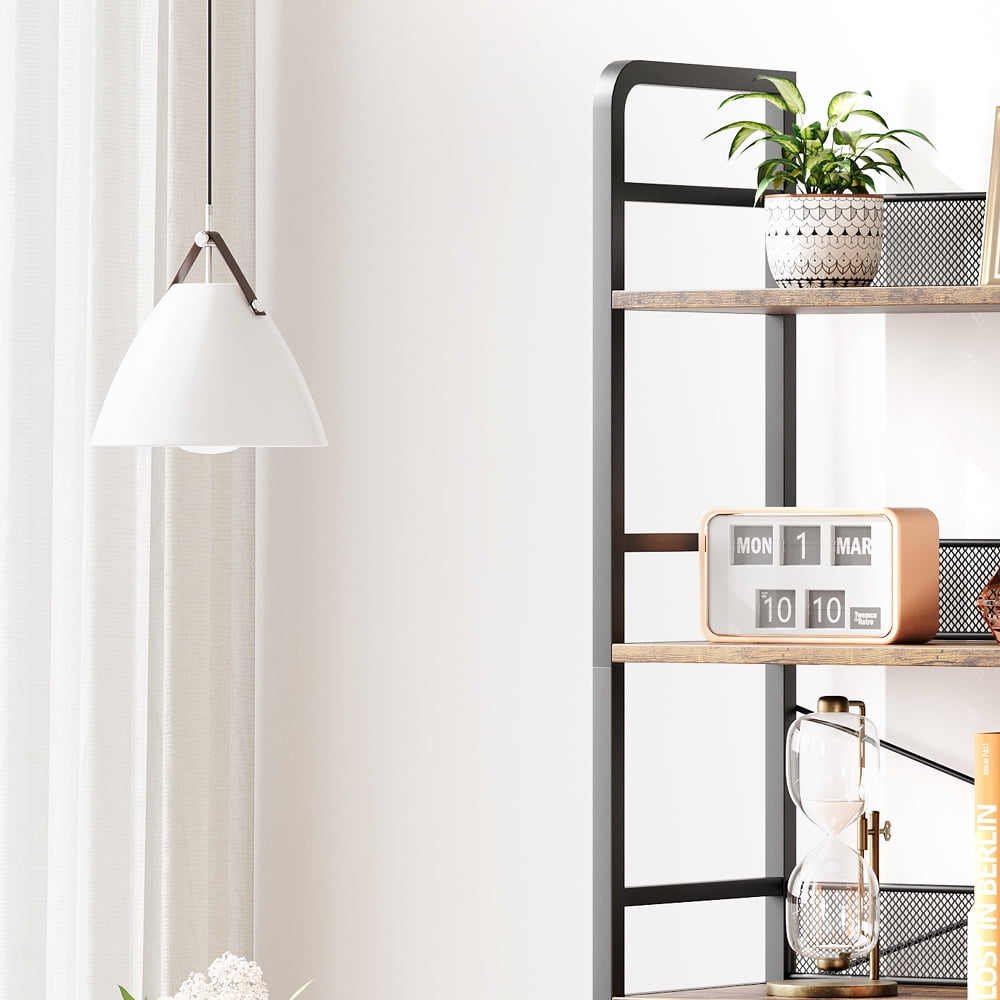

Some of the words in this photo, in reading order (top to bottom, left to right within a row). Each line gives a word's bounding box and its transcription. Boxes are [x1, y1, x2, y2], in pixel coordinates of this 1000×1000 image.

[737, 536, 772, 555] MON
[796, 531, 806, 560] 1
[836, 536, 872, 555] MAR
[763, 596, 792, 623] 10
[813, 596, 842, 623] 10
[976, 803, 998, 896] BERLIN
[976, 903, 998, 930] IN
[976, 936, 998, 1000] LOST
